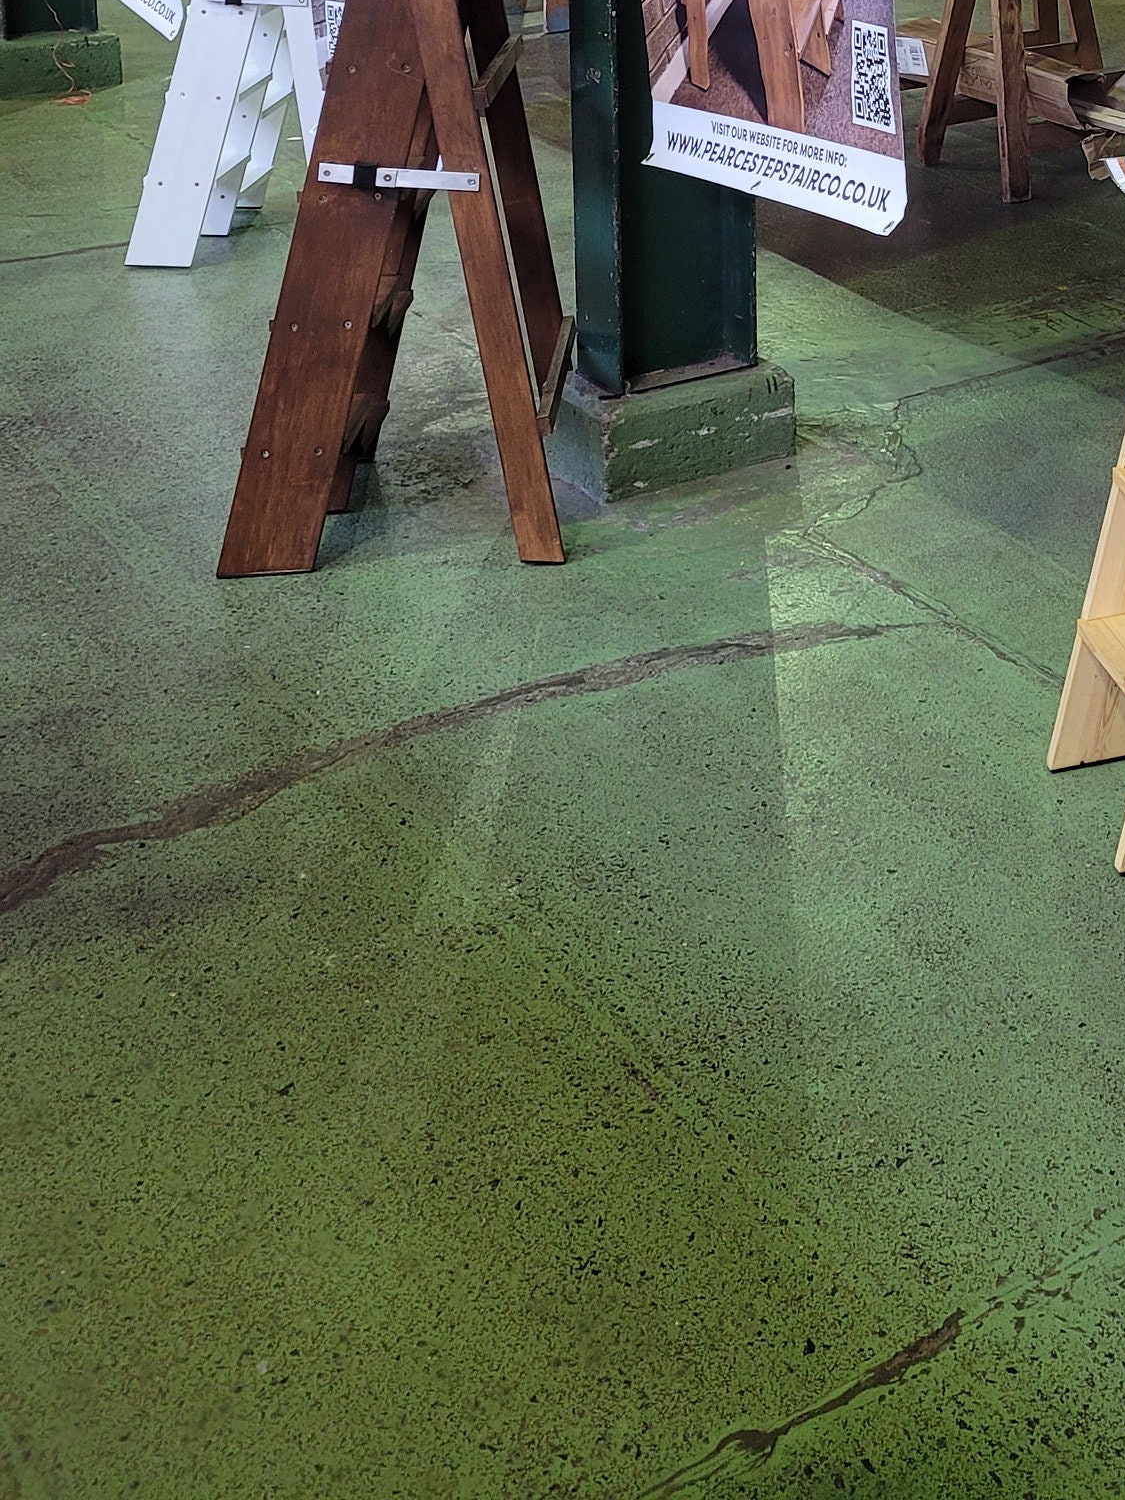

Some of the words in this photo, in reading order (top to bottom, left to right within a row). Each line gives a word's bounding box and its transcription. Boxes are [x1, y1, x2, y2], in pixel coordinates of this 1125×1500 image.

[667, 131, 891, 213] WWW.PEARCESTEPSTAIRCO.CO.UK
[711, 120, 730, 136] VISIT
[731, 125, 748, 142] OUR
[749, 129, 782, 152] WEBSITE
[783, 138, 799, 155] FOR
[800, 143, 825, 162] MORE
[825, 149, 848, 168] INFO:
